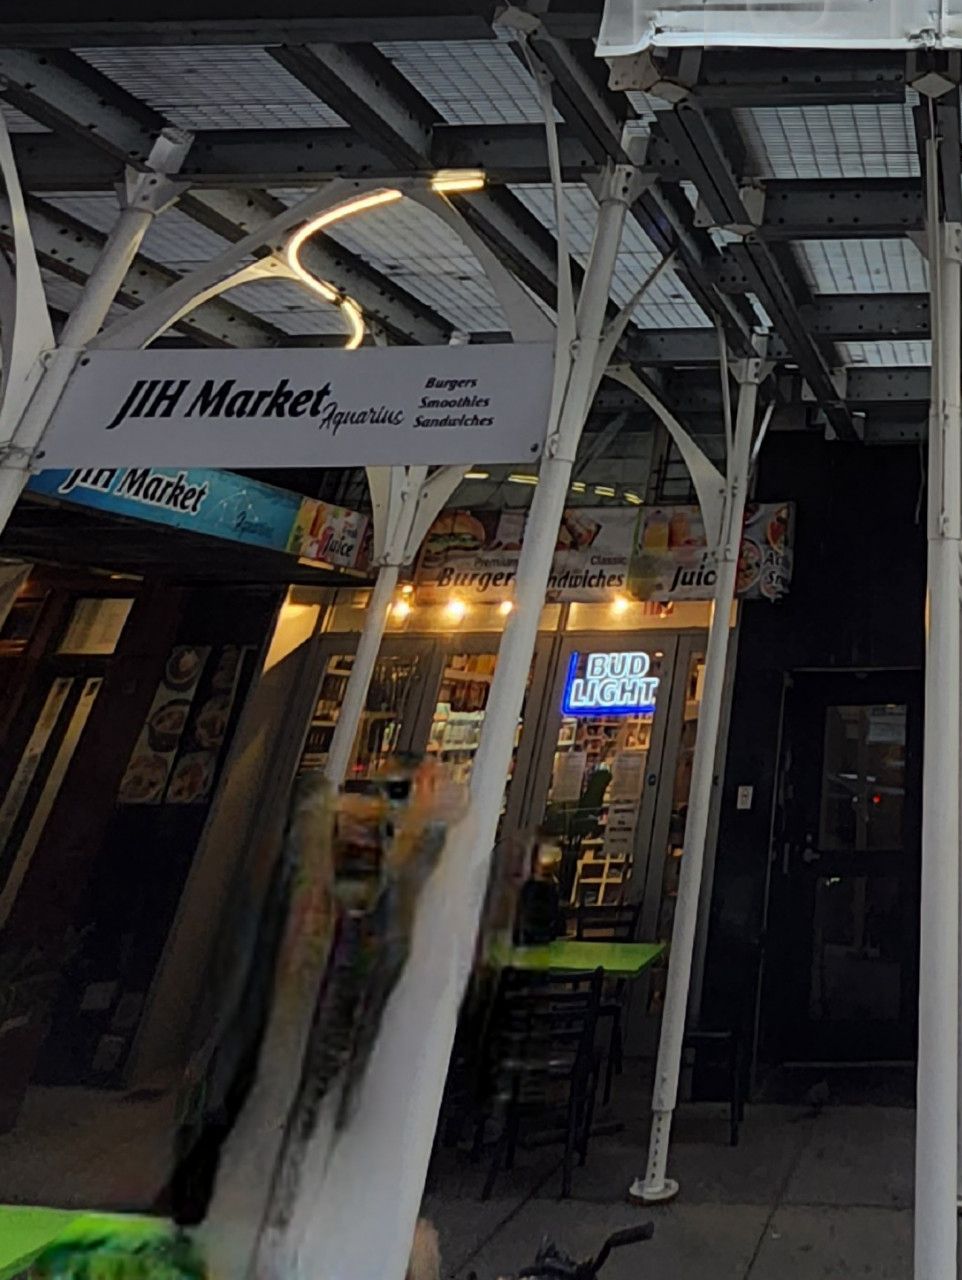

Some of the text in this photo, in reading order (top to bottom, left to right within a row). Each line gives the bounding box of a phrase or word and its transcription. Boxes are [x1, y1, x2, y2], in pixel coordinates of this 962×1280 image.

[425, 377, 478, 391] Burgers
[184, 379, 332, 418] Market
[418, 395, 490, 409] Smoothies
[318, 402, 404, 436] Aquarius
[412, 414, 495, 428] Sandwiches
[117, 468, 208, 513] Market
[590, 556, 627, 567] Classic
[547, 569, 625, 589] ndwiches
[586, 651, 650, 679] BUD
[569, 677, 660, 707] LIGHT
